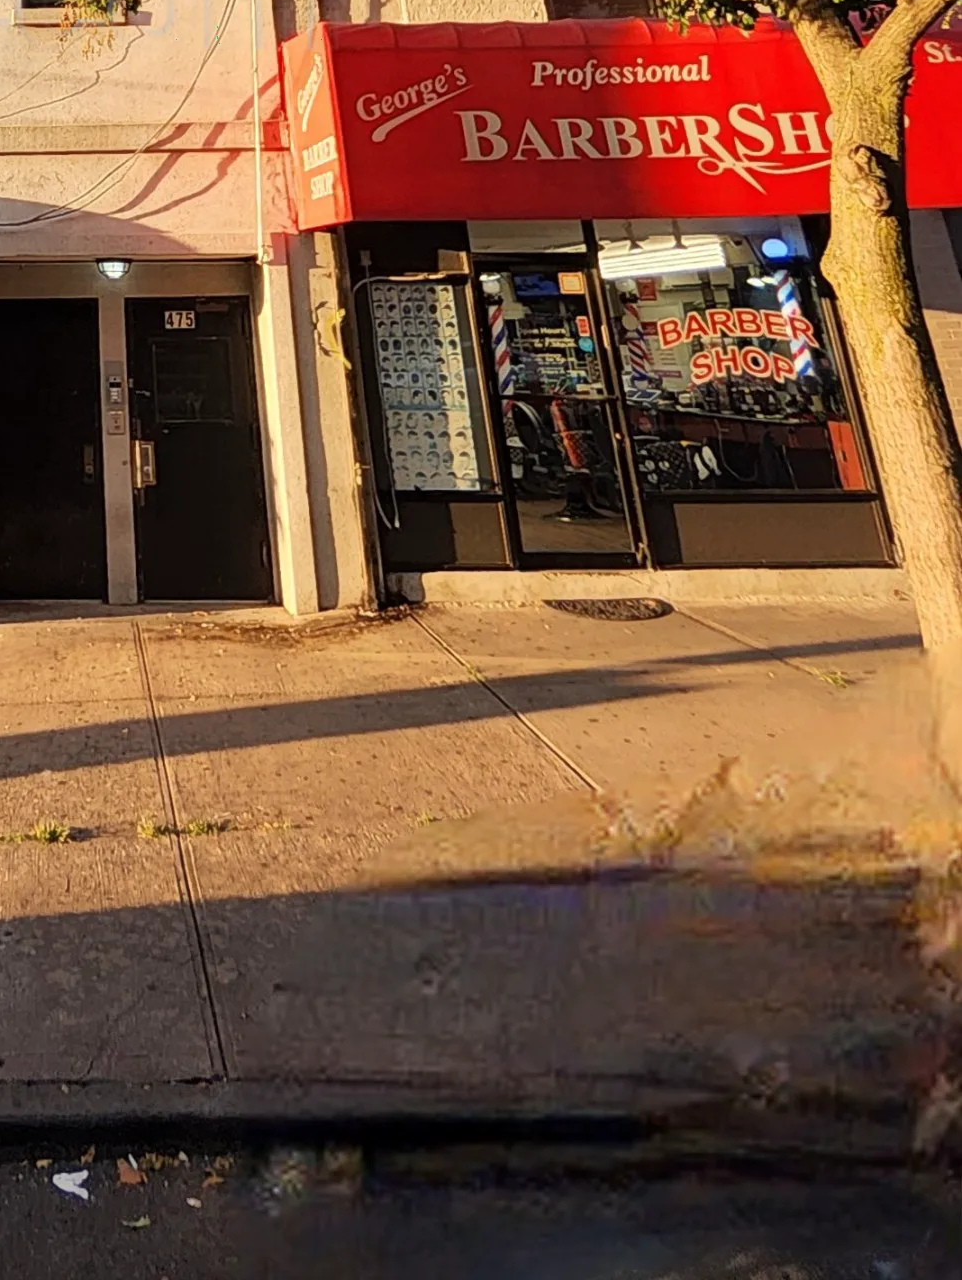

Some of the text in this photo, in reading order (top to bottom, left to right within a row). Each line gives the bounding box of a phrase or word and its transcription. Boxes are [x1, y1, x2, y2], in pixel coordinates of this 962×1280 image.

[355, 63, 468, 122] George's
[530, 54, 712, 91] Professional
[453, 102, 911, 164] BARBERSH
[166, 311, 194, 328] 475
[657, 307, 820, 350] BARBER
[690, 345, 798, 386] SHOP
